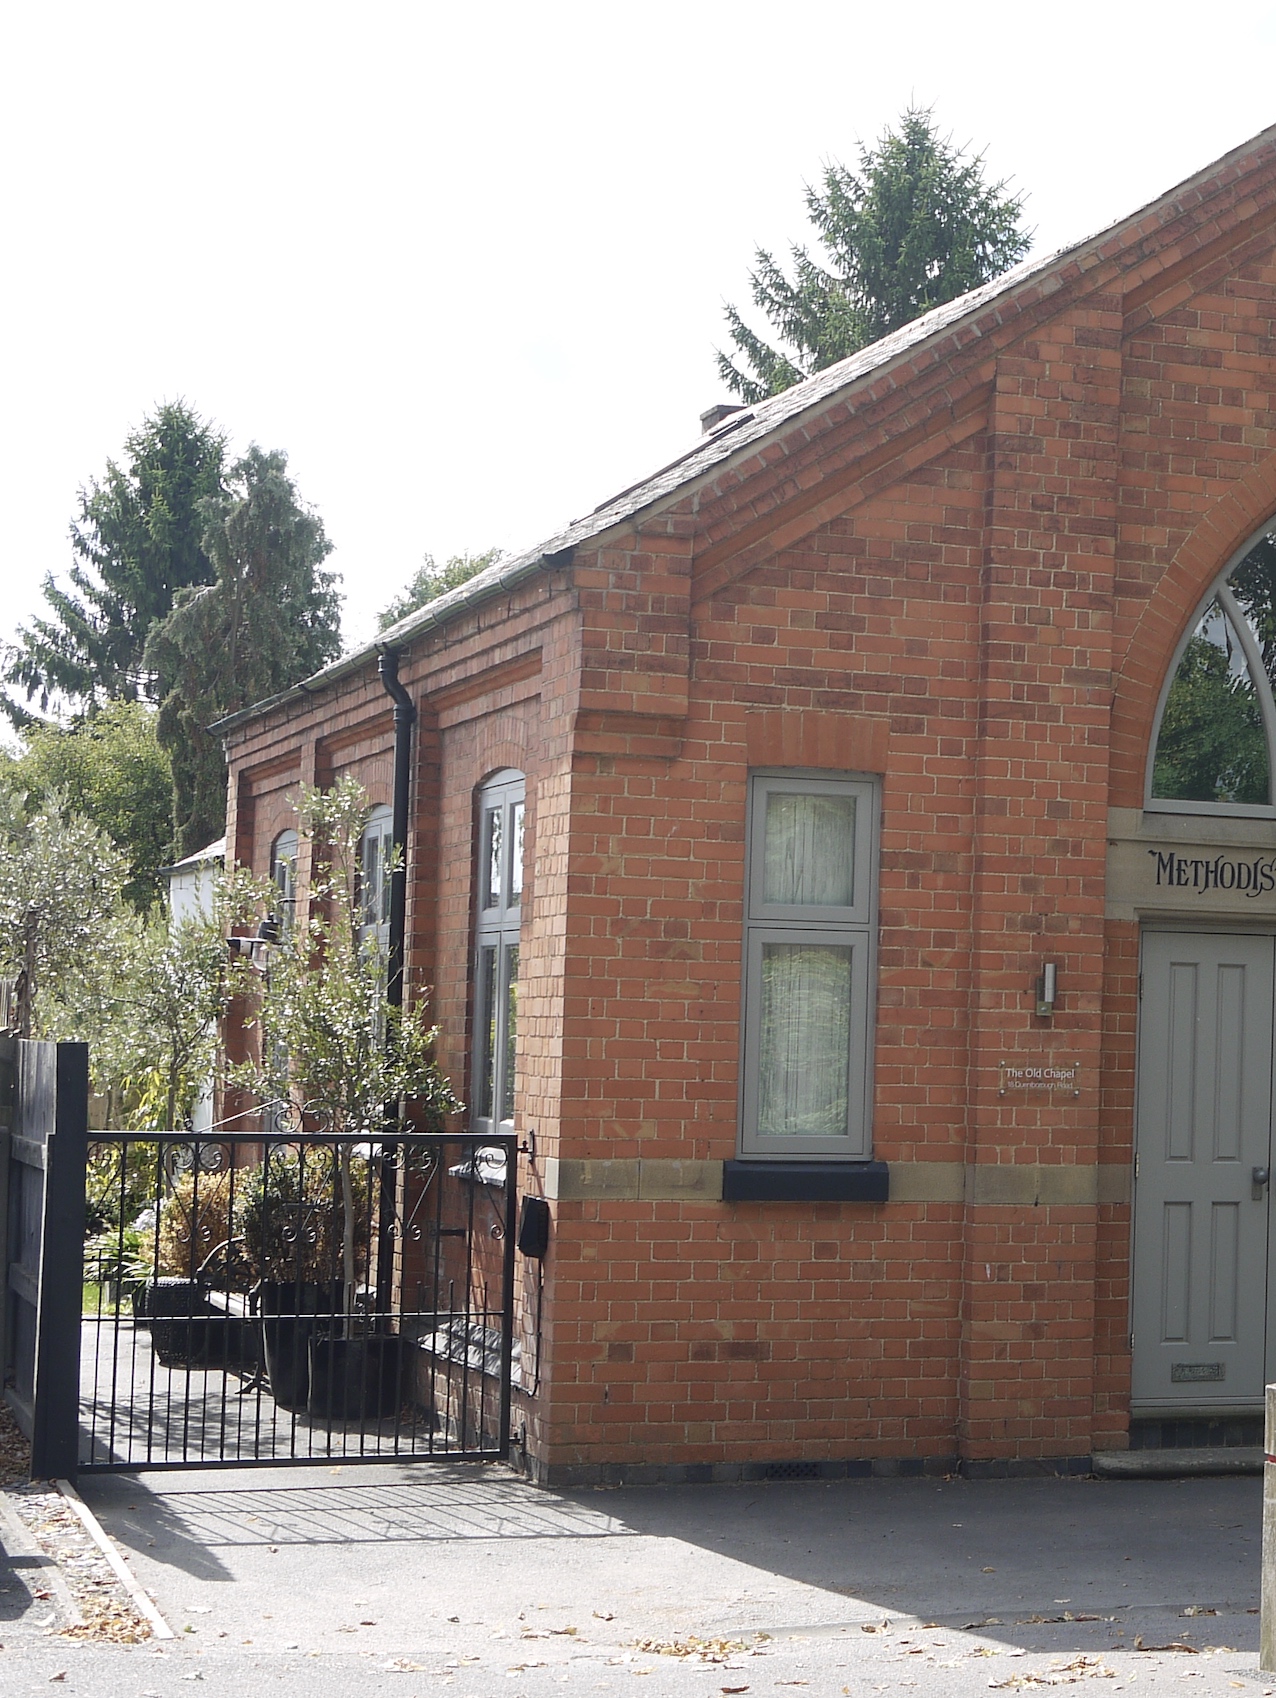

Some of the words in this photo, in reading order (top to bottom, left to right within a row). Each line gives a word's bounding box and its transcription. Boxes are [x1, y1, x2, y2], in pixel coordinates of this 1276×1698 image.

[1005, 1068, 1023, 1078] The
[1025, 1068, 1042, 1078] Old
[1043, 1068, 1075, 1081] Chapel
